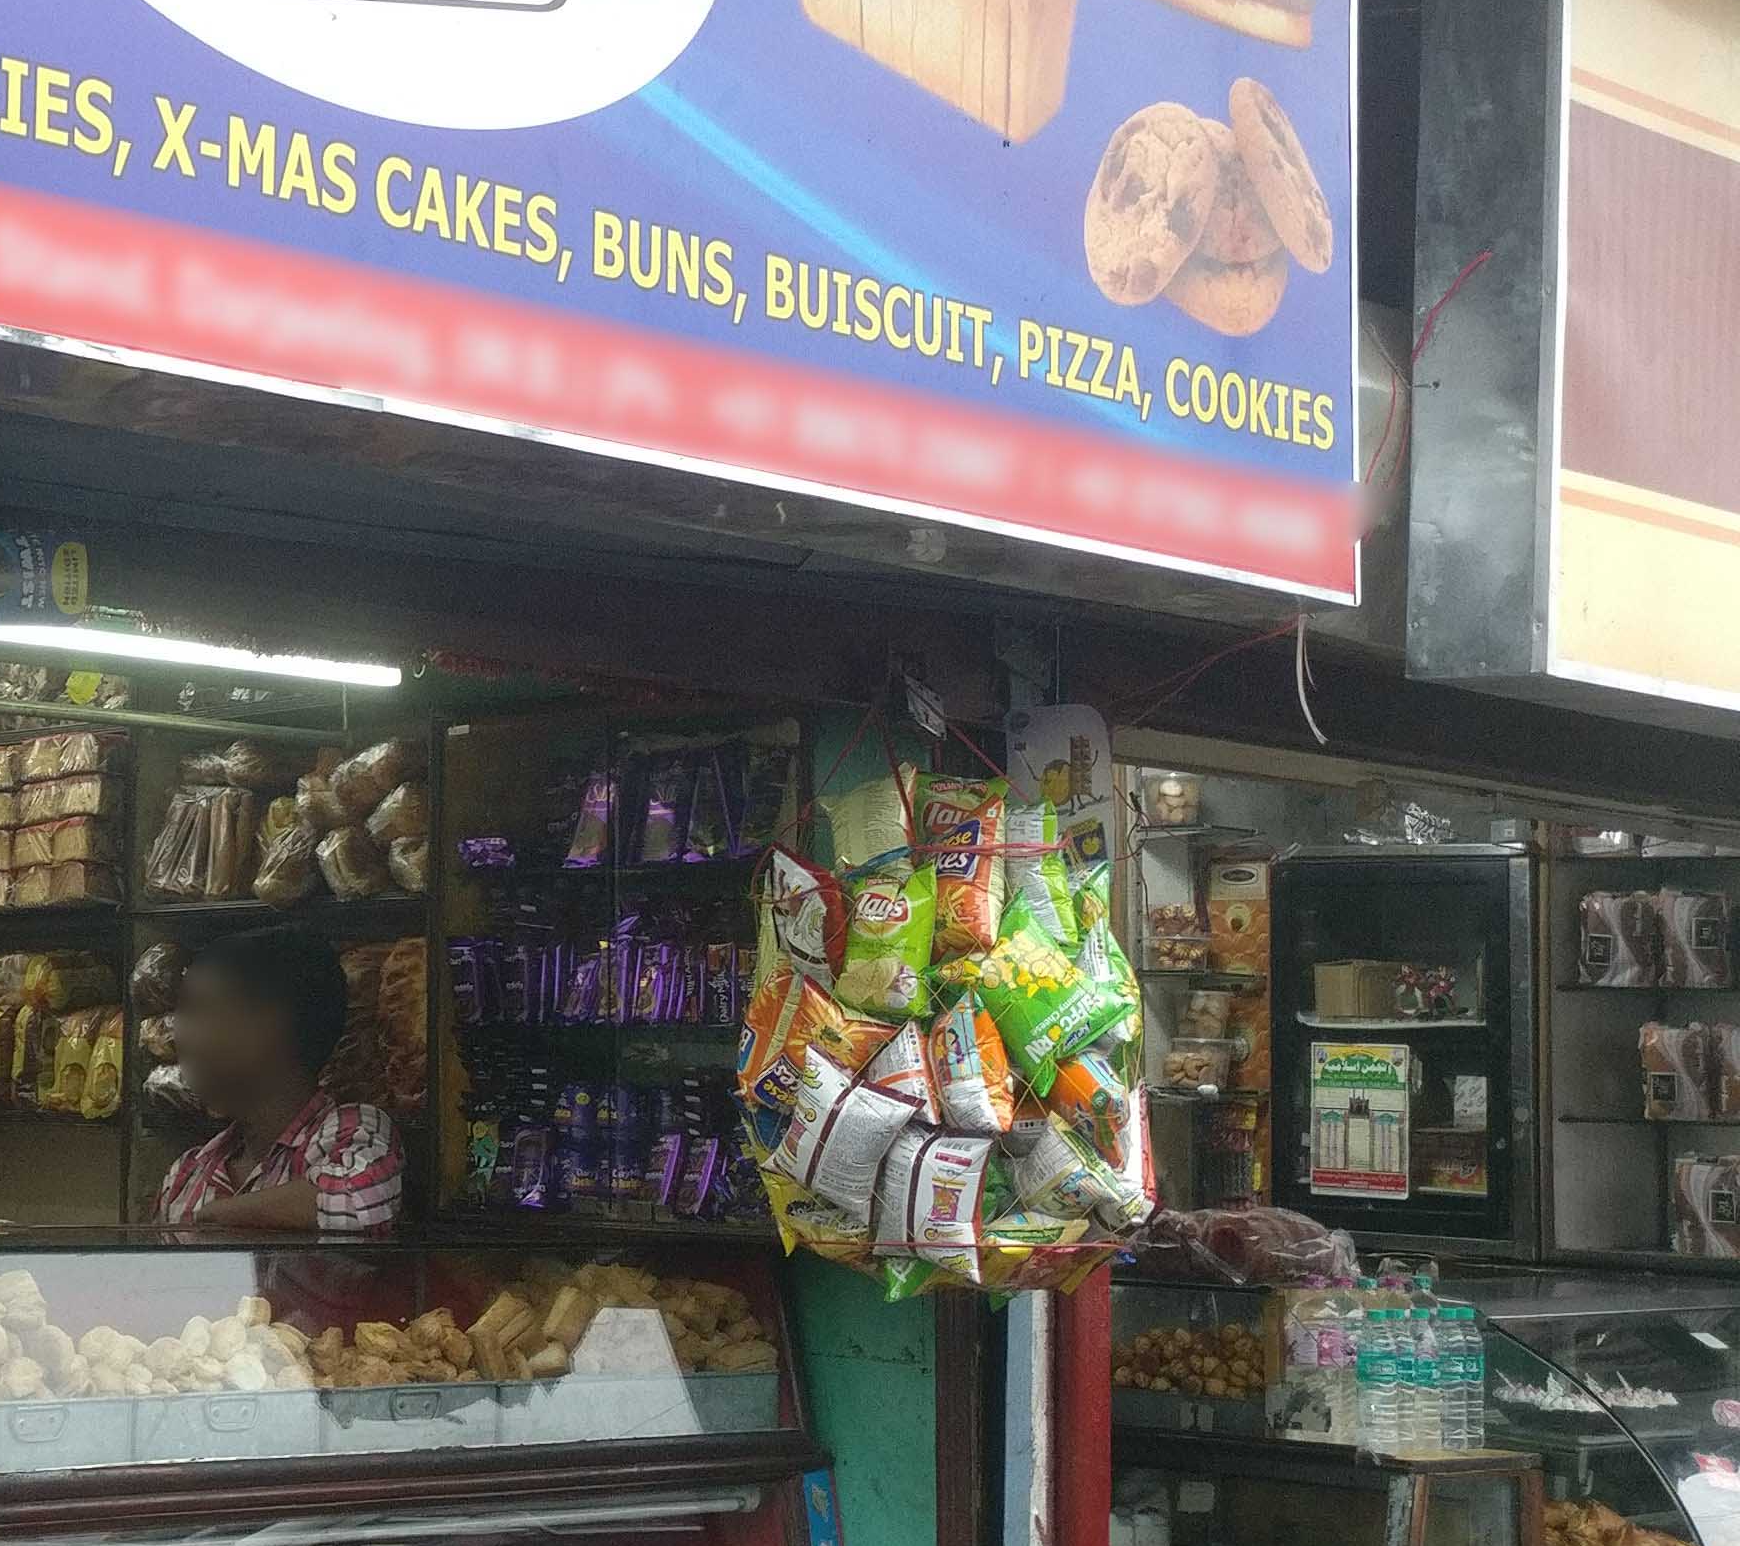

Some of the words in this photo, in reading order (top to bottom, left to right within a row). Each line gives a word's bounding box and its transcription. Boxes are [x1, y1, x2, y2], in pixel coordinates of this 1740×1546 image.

[153, 95, 357, 215] X-MAS
[375, 154, 574, 283] CAKES,
[592, 209, 748, 324] BUNS,
[765, 252, 1002, 386] BUISCUIT,
[1018, 319, 1153, 420] PIZZA,
[1164, 356, 1335, 452] COOKIES
